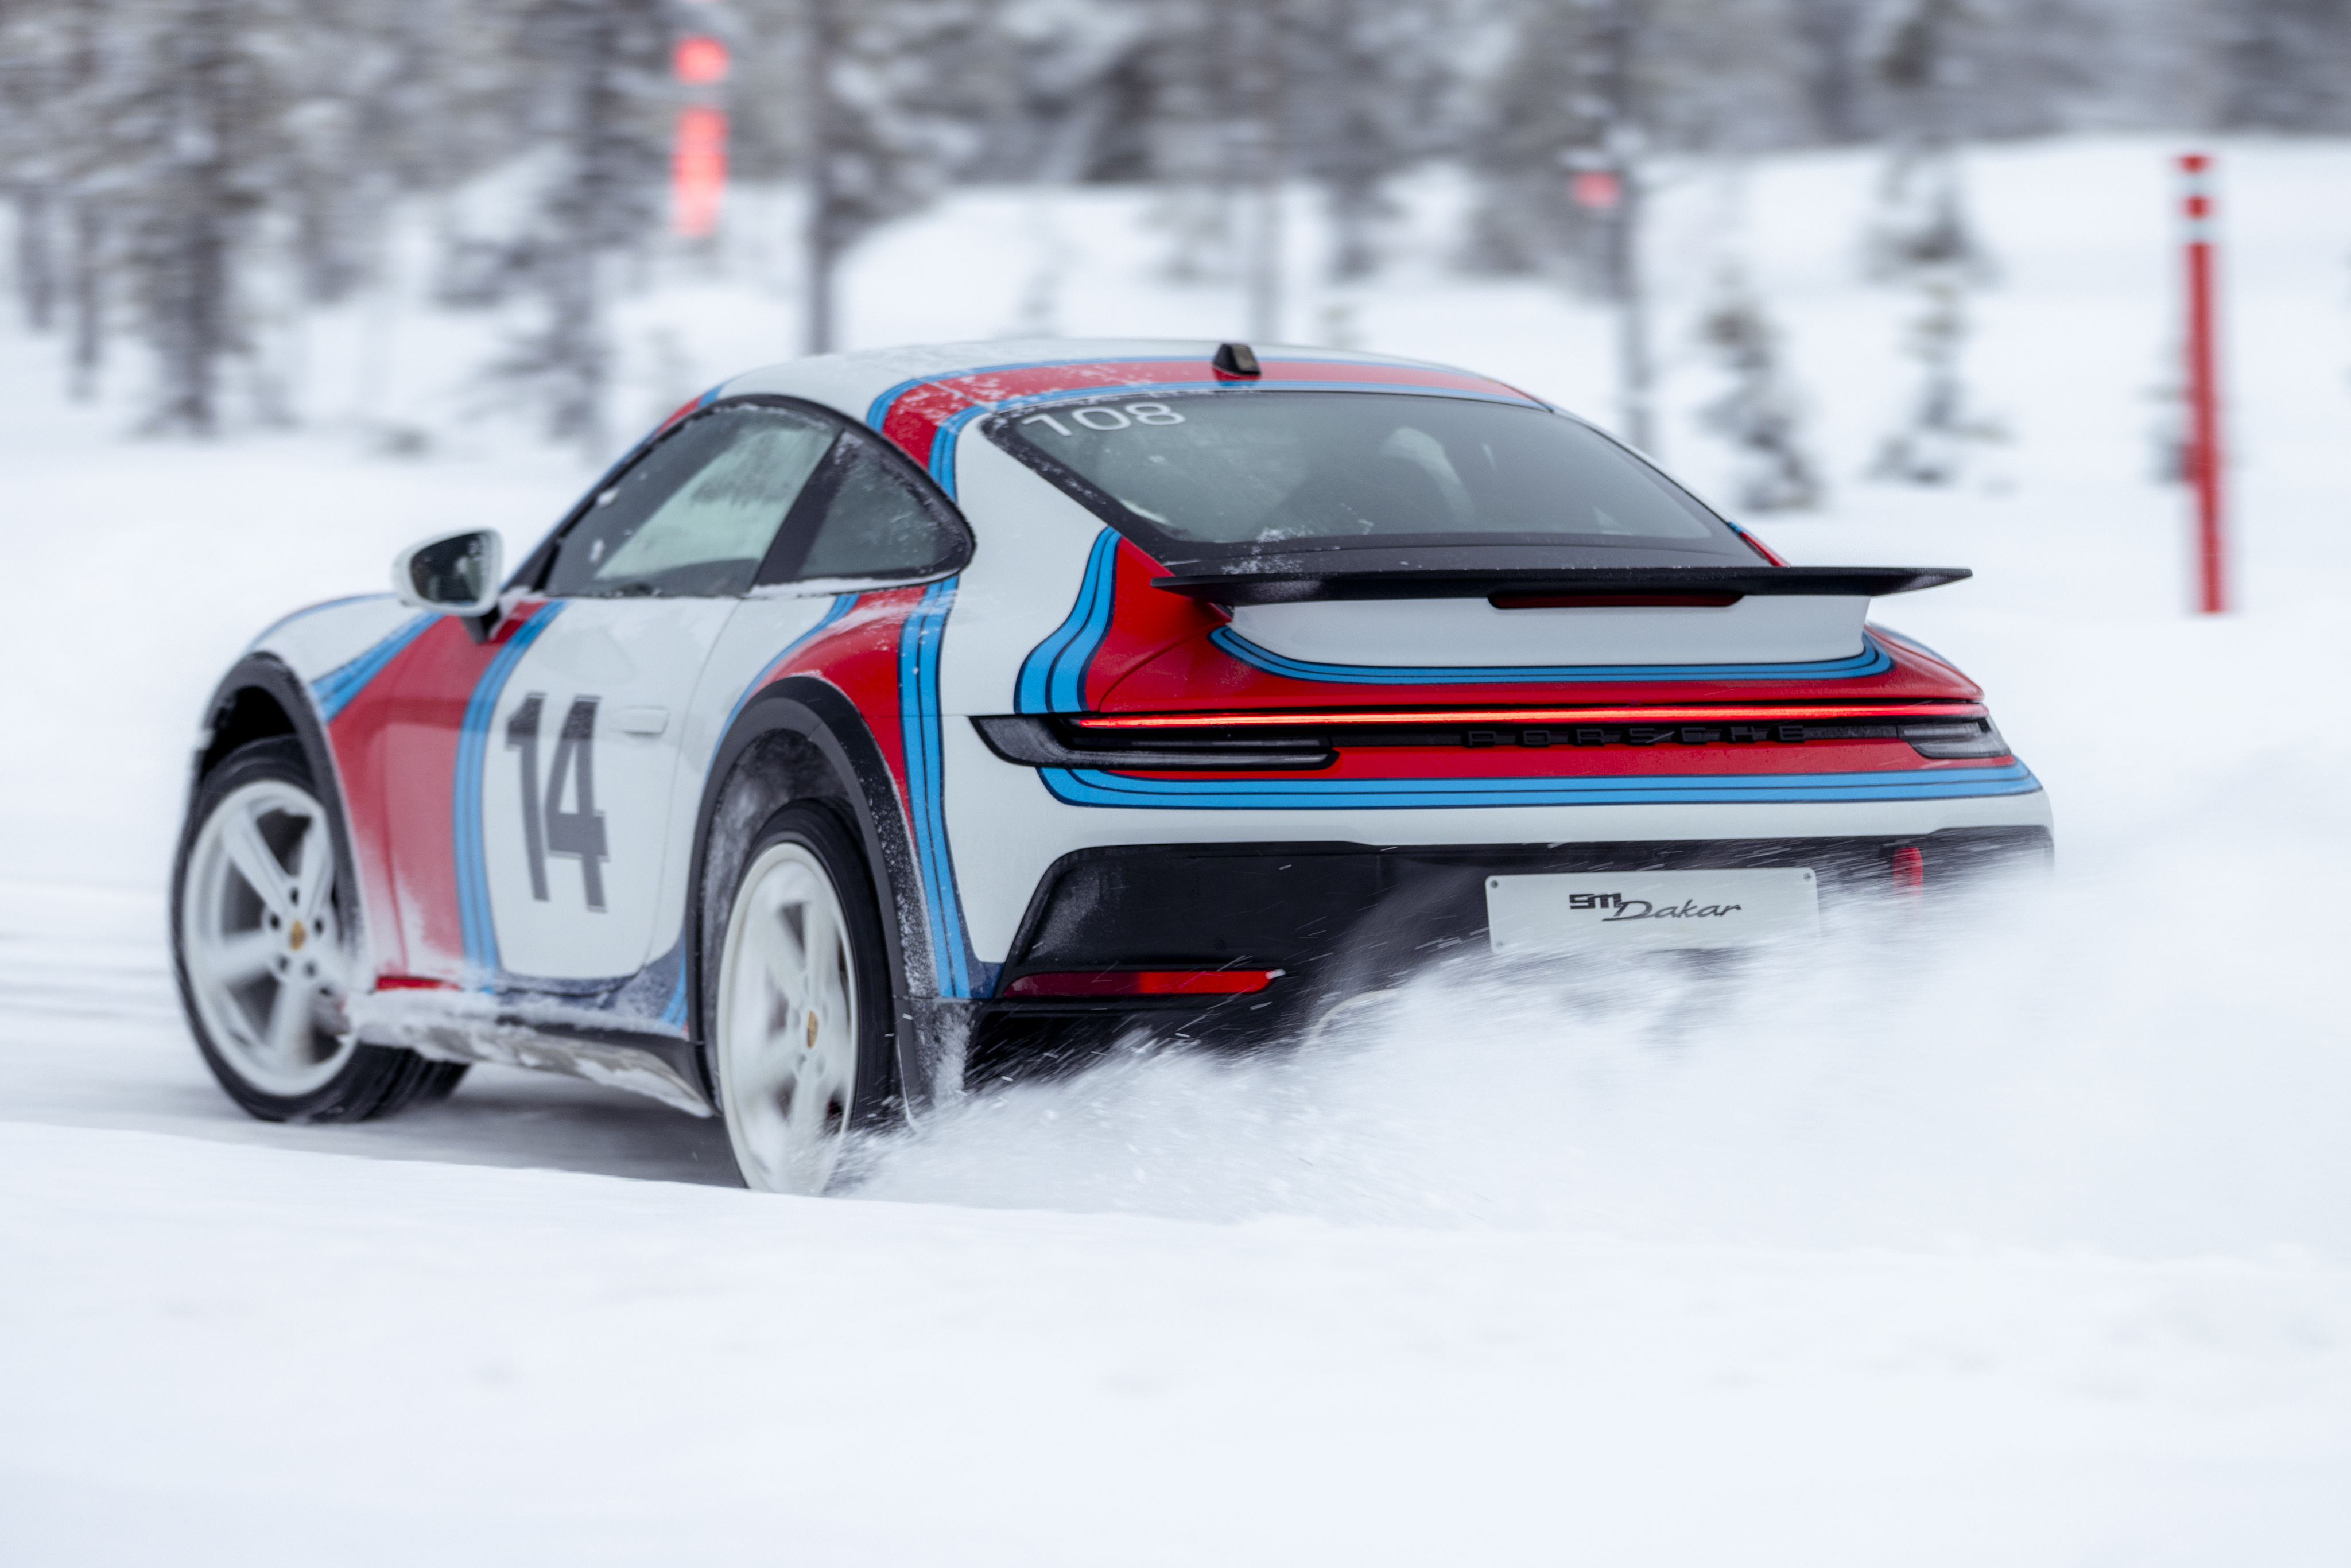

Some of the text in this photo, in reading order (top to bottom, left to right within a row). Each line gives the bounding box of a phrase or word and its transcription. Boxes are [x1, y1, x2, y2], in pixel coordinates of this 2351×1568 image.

[1021, 401, 1186, 437] 108
[1466, 725, 1806, 747] PORSCHE
[505, 692, 610, 913] 14
[1601, 898, 1742, 922] Dakar
